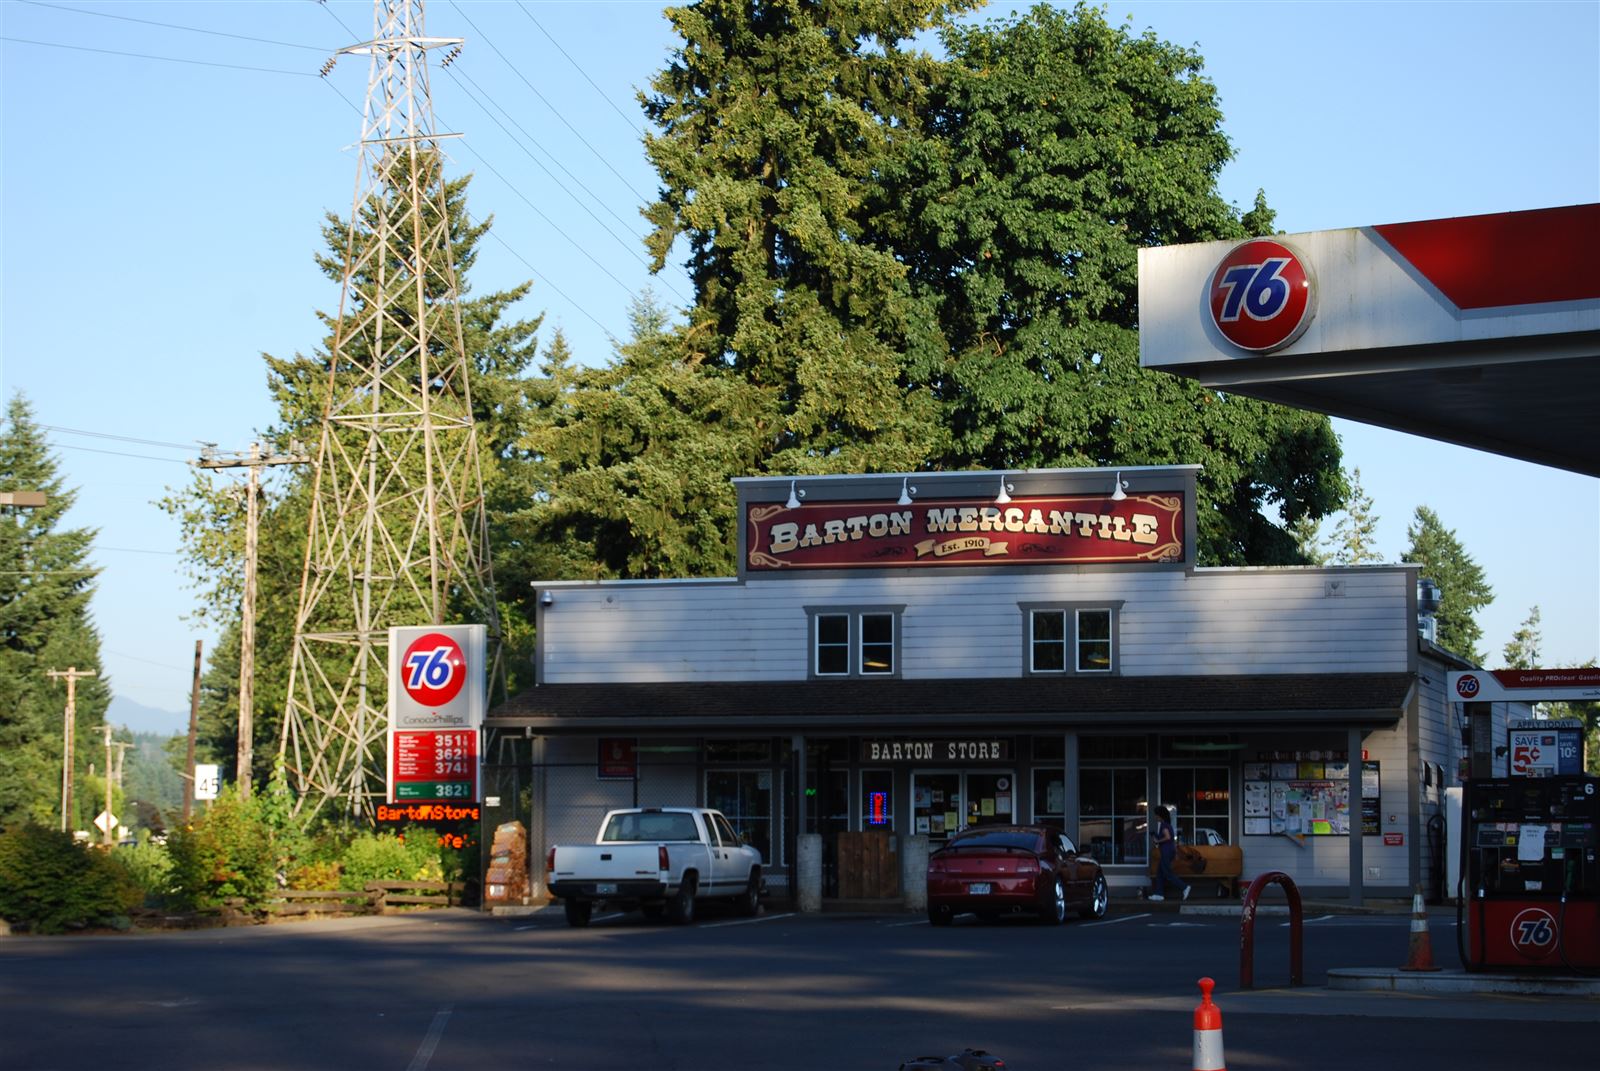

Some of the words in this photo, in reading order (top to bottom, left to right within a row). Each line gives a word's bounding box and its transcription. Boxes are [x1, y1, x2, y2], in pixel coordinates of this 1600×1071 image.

[1219, 257, 1293, 322] 76
[770, 511, 913, 554] BARTON
[926, 507, 1159, 545] MERCANTILE
[941, 542, 961, 553] Est.
[964, 538, 985, 549] 1910
[406, 646, 454, 690] 76
[1459, 679, 1478, 692] 76
[1519, 675, 1544, 684] Quality
[1517, 720, 1541, 728] APPLY
[1545, 719, 1574, 728] TODAY!
[435, 735, 462, 747] 351
[1515, 736, 1539, 746] SAVE
[435, 748, 462, 761] 362
[871, 743, 934, 760] BARTON
[948, 742, 1000, 759] STORE
[435, 762, 462, 774] 374
[200, 778, 220, 794] 45
[435, 785, 463, 797] 382
[1584, 783, 1594, 795] 6
[1518, 918, 1553, 946] 76
